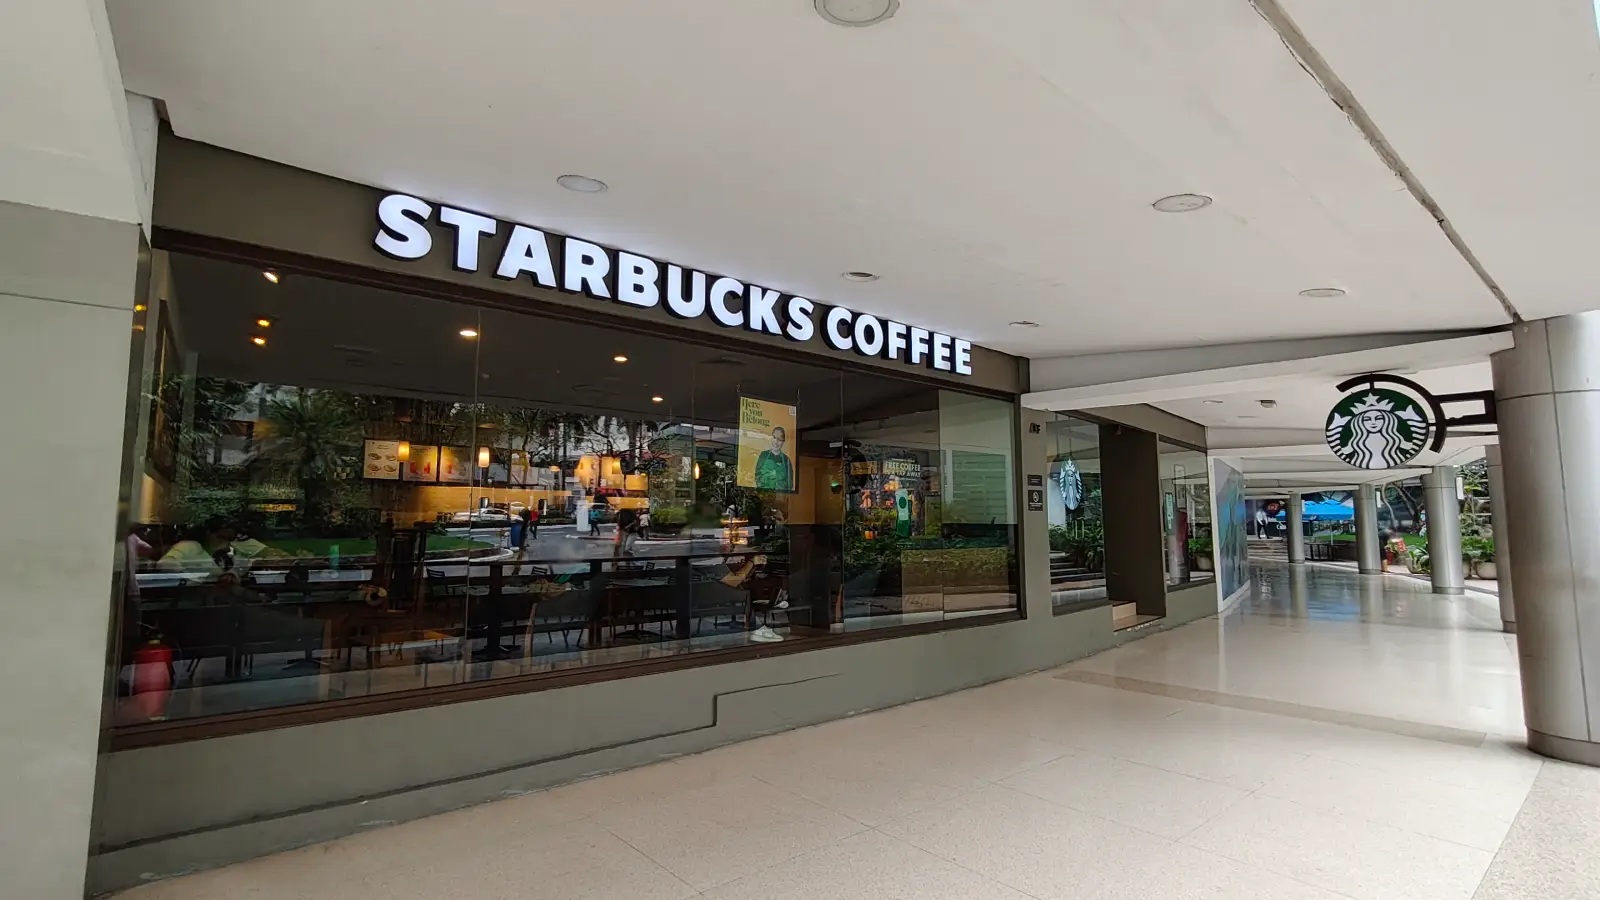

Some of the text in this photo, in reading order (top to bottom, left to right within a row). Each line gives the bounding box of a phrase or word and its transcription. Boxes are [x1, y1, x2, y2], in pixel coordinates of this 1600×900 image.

[374, 193, 972, 376] STARBUCKS COFFEE
[742, 398, 760, 410] Here
[749, 409, 762, 417] you
[885, 461, 921, 471] FREE COFFEE
